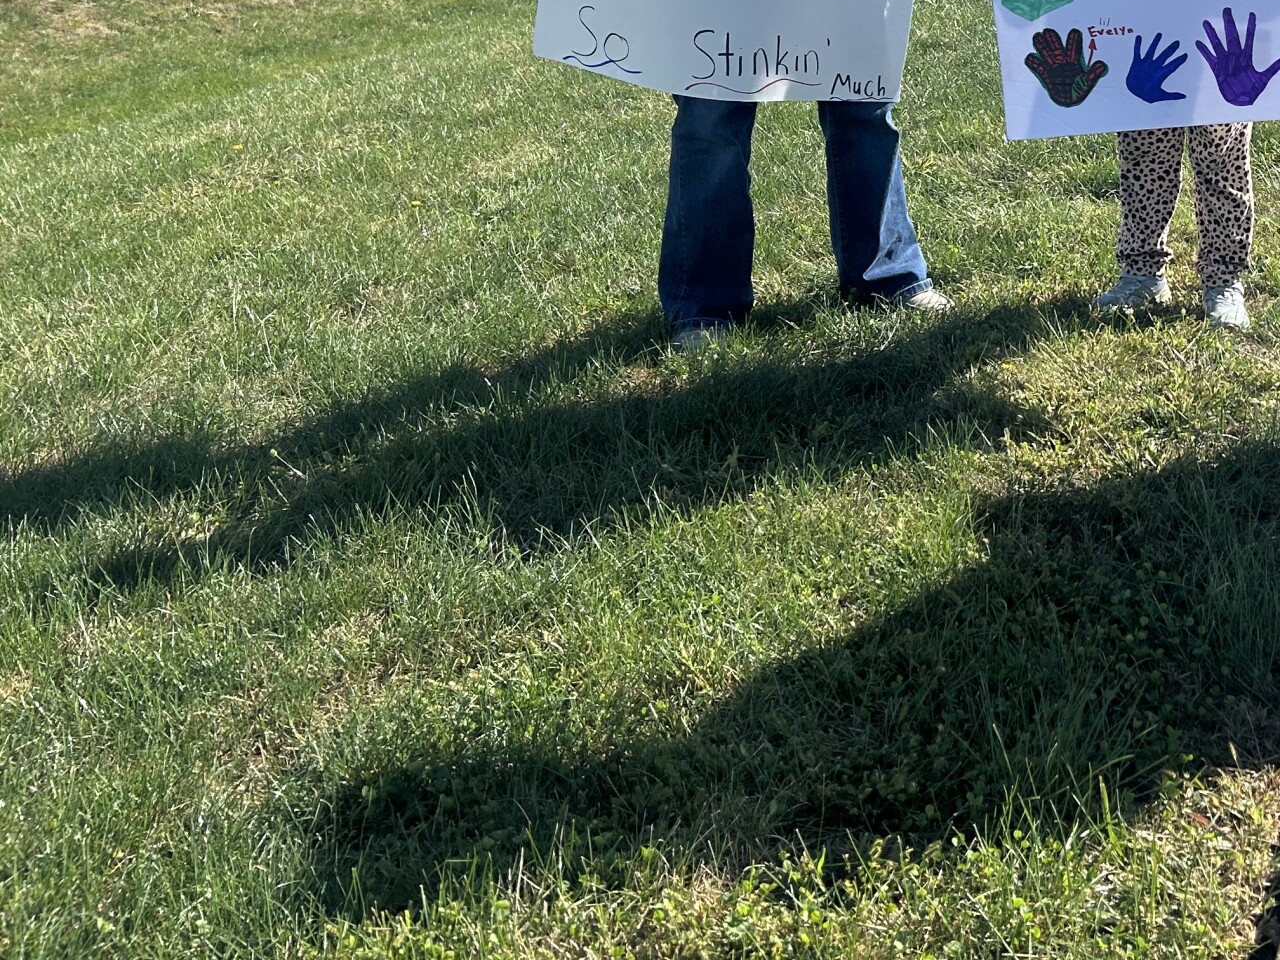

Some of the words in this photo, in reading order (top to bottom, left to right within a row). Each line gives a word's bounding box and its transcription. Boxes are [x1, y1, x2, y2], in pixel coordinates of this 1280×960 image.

[571, 5, 630, 62] So
[1087, 25, 1134, 38] Evelyn
[692, 29, 831, 80] Stinkin'
[830, 73, 886, 97] Much
